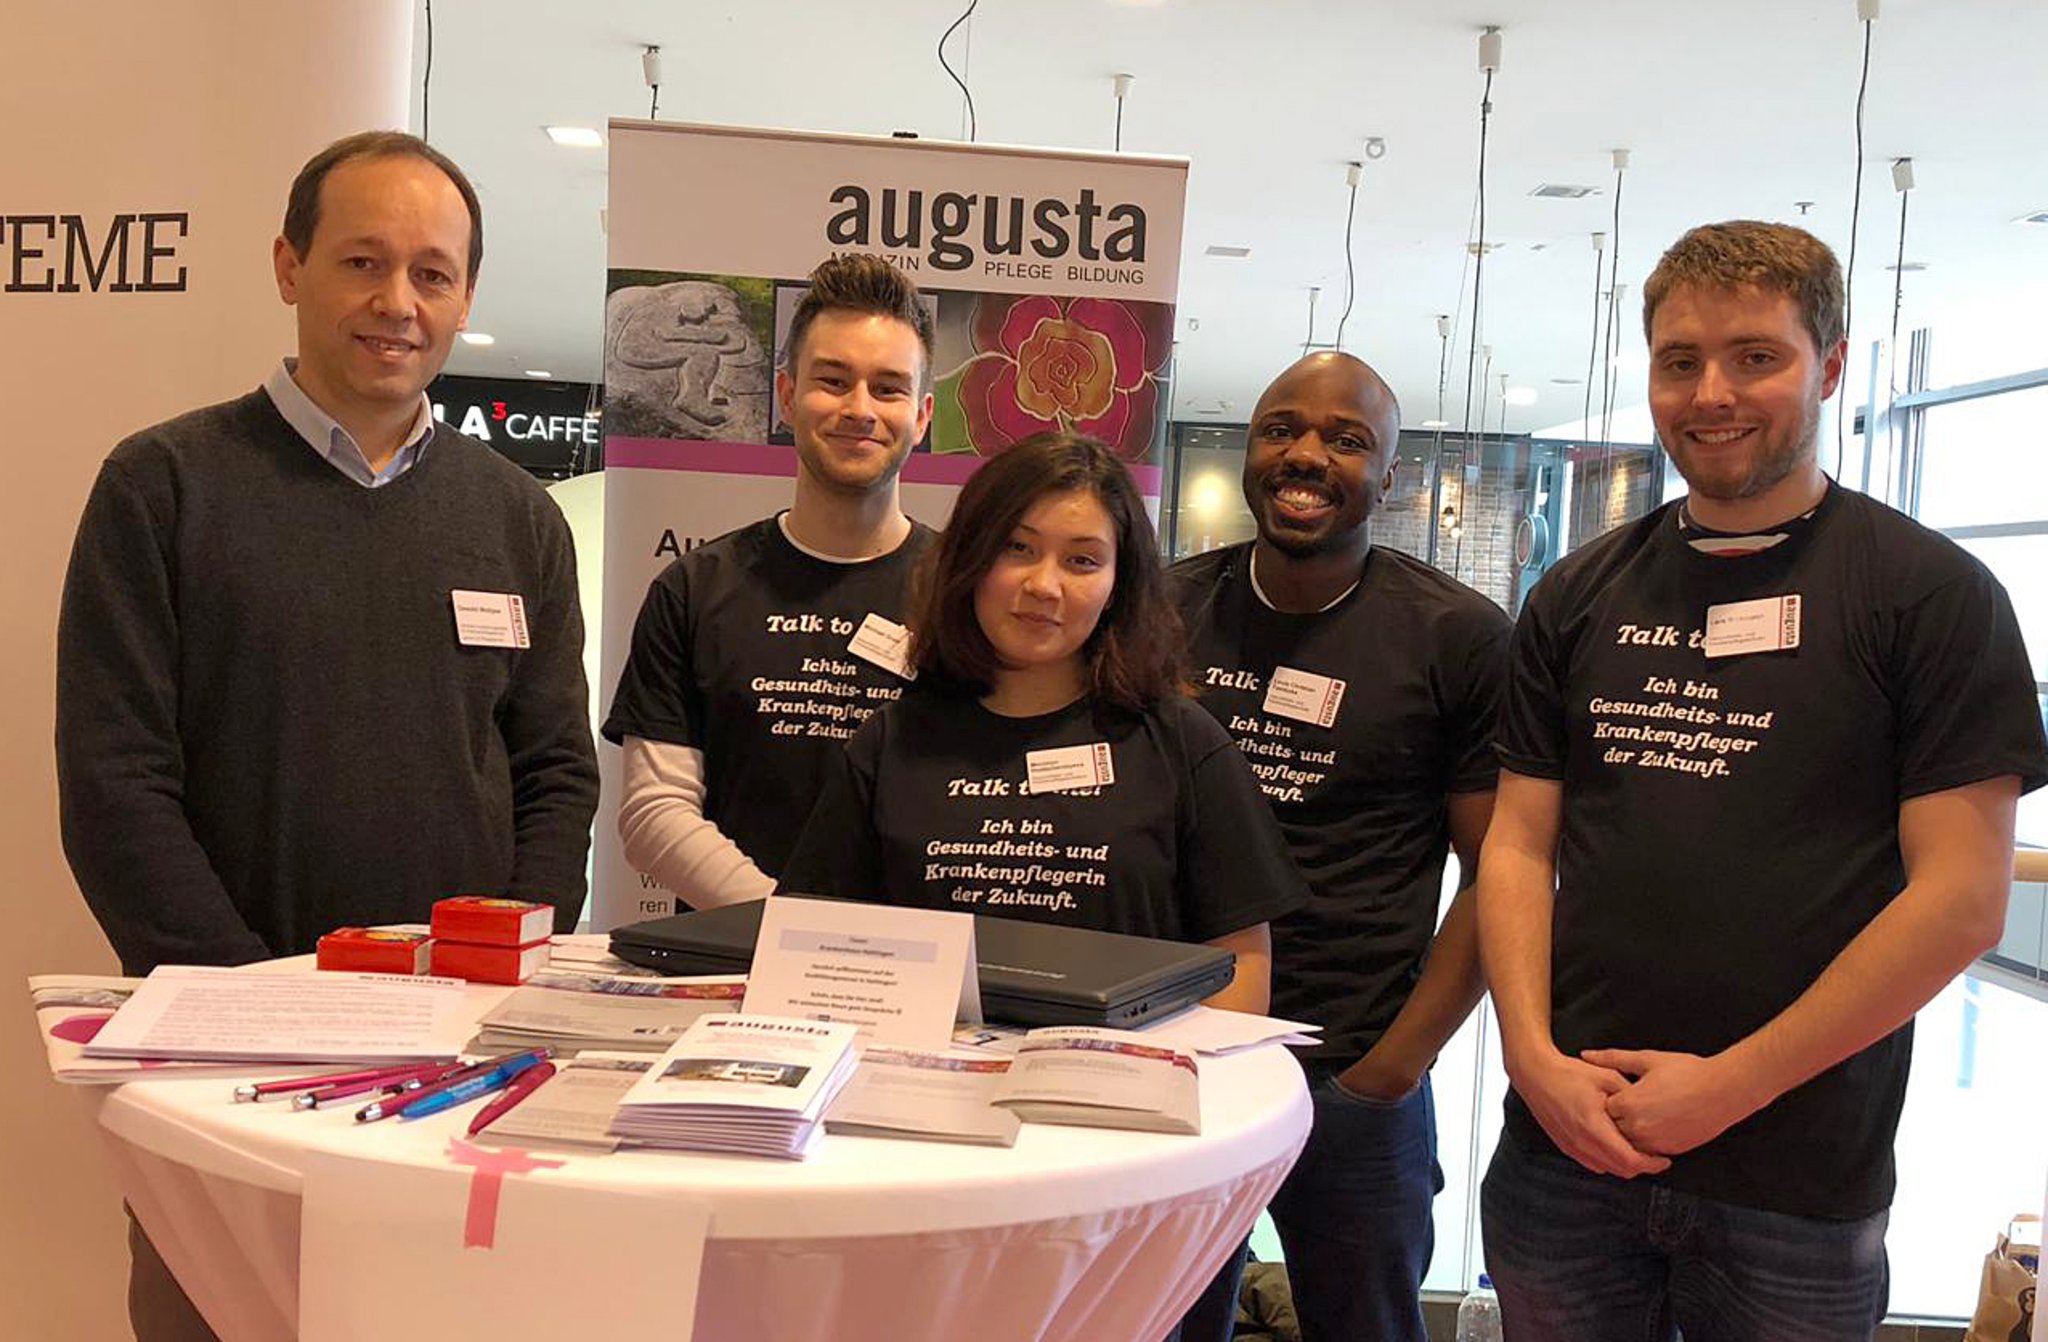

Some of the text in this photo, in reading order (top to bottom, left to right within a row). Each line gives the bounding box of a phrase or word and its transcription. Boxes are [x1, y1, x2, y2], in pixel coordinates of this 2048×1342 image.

[826, 185, 1147, 271] augusta
[0, 213, 188, 293] EME
[984, 261, 1053, 280] PFLEGE
[1067, 265, 1144, 284] BILDUNG
[767, 615, 824, 632] Talk
[830, 617, 853, 635] to
[1617, 625, 1680, 646] Talk
[1206, 667, 1260, 690] Talk
[1644, 677, 1719, 699] Ich bin
[866, 687, 903, 700] und
[1589, 698, 1774, 728] Gesundheits- und
[771, 720, 803, 735] der
[1229, 715, 1291, 737] Ich bin
[1593, 722, 1758, 754] Krankenpfleger
[1300, 751, 1336, 765] und
[1603, 747, 1731, 778] der Zukunft.
[948, 779, 1009, 796] Talk
[1260, 784, 1304, 802] unft.
[980, 820, 1053, 834] Ich bin
[926, 841, 1109, 861] Gesundheits- und
[925, 863, 1106, 886] Krankenpflegerin
[640, 901, 668, 913] ren
[951, 886, 1078, 910] der Zukunft.
